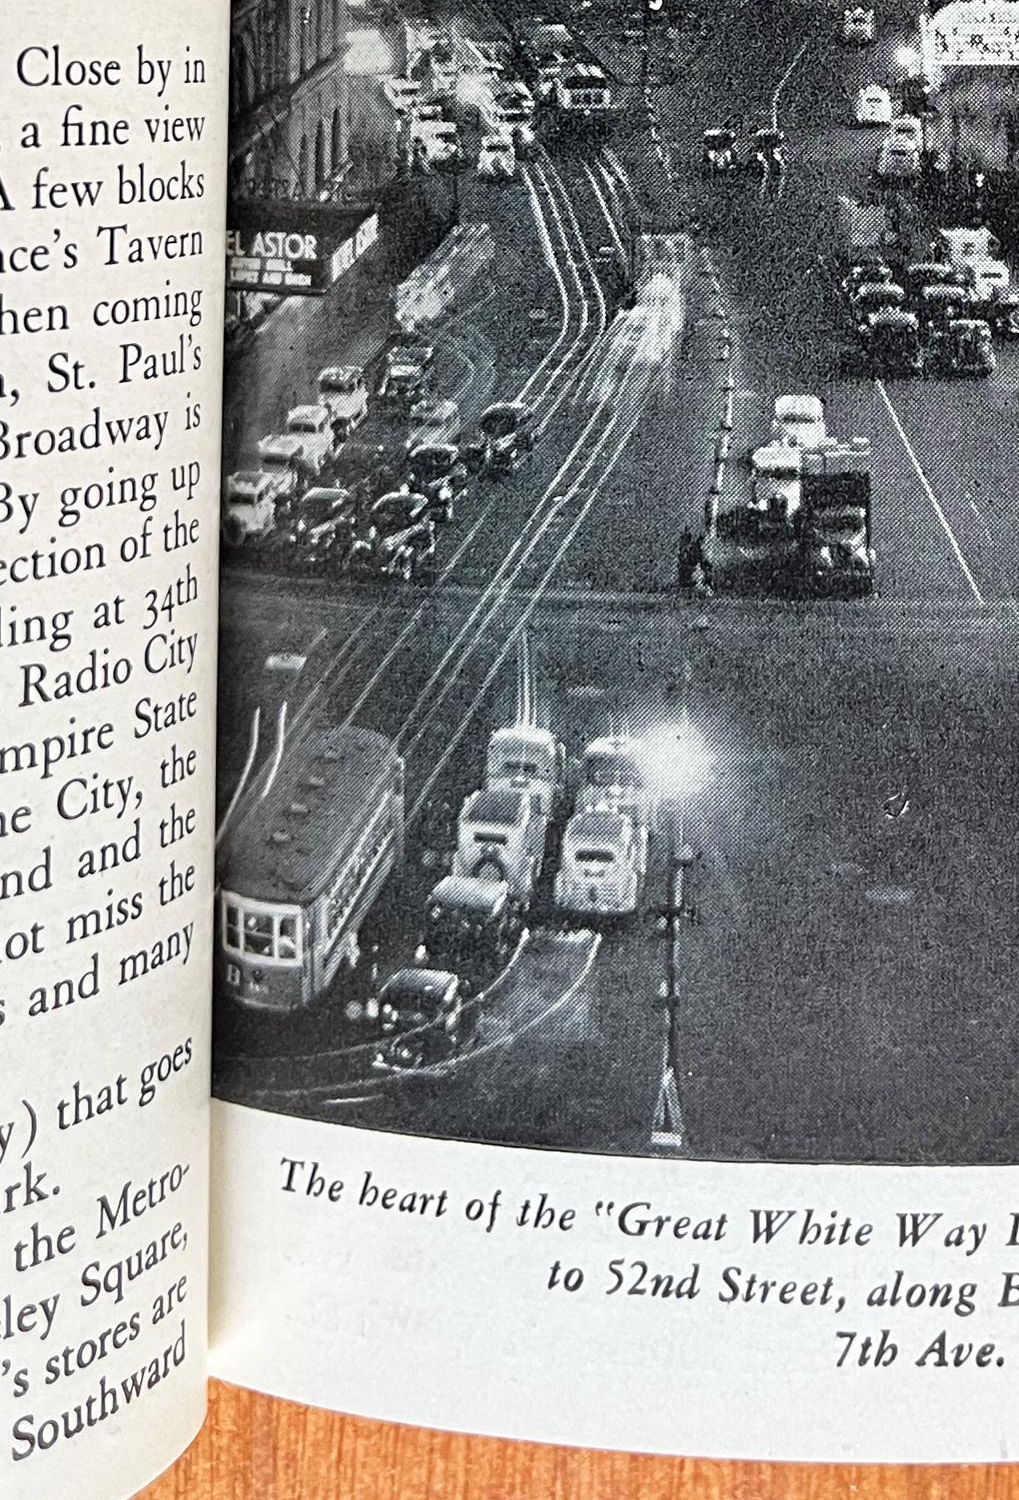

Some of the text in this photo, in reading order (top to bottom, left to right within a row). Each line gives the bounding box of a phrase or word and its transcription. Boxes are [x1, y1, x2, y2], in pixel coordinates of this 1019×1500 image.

[17, 44, 205, 97] Close by in
[21, 104, 205, 148] a fine view
[32, 167, 103, 209] few
[118, 160, 204, 204] blocks
[97, 224, 202, 265] Tavern
[251, 231, 319, 261] ASTOR
[93, 280, 202, 327] coming
[48, 353, 95, 392] St.
[119, 334, 201, 383] Paul's
[185, 392, 200, 430] is
[58, 467, 158, 527] going
[171, 462, 200, 500] up
[120, 516, 153, 562] of
[163, 509, 199, 552] the
[0, 563, 197, 652] ing at 34th
[19, 629, 197, 707] Radio City
[135, 692, 196, 738] State
[57, 773, 142, 820] City,
[160, 744, 196, 788] the
[78, 818, 141, 878] and
[160, 803, 195, 848] the
[66, 889, 142, 944] miss
[159, 860, 194, 906] the
[29, 922, 193, 1016] and many
[57, 1075, 127, 1130] that
[139, 1037, 191, 1107] goes
[14, 1165, 189, 1272] the Metro-
[281, 1158, 343, 1202] The
[359, 1172, 447, 1217] heart
[466, 1190, 501, 1232] of
[517, 1193, 575, 1231] the
[596, 1201, 727, 1241] "Great
[896, 1213, 986, 1256] Way
[81, 1223, 187, 1306] Square,
[548, 1261, 583, 1292] to
[606, 1259, 700, 1299] 52nd
[719, 1267, 845, 1313] Street,
[867, 1271, 977, 1317] along
[44, 1315, 141, 1387] stores
[153, 1276, 186, 1324] are
[836, 1330, 897, 1367] 7th
[915, 1331, 1004, 1367] Ave.
[11, 1320, 187, 1462] Southward
